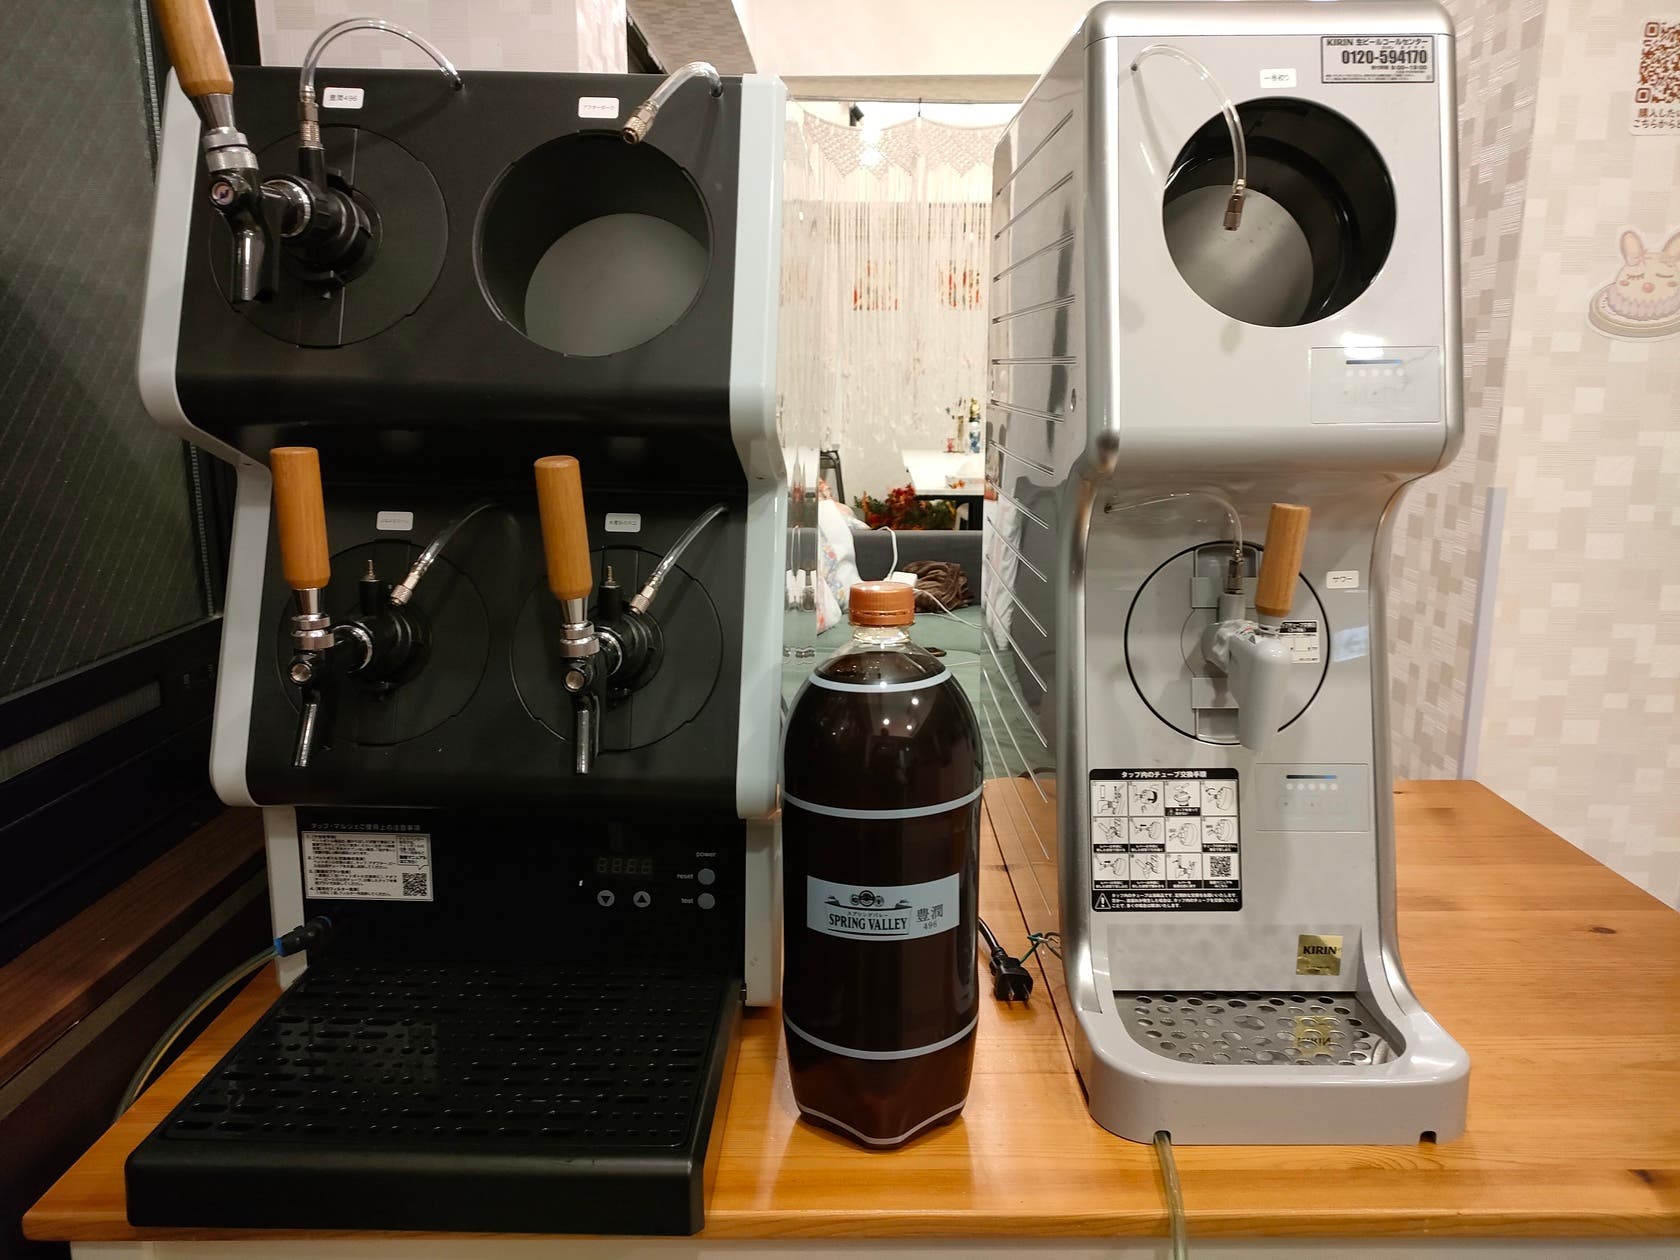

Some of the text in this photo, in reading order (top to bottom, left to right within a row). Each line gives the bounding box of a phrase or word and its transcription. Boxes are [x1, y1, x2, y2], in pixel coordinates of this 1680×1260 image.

[1356, 38, 1429, 46] 生ビールコールセンター
[1341, 50, 1428, 64] 0120-594170
[915, 903, 944, 922] 豊潤
[828, 913, 908, 931] SPRING VALLEY
[923, 921, 938, 930] 496
[1303, 945, 1337, 955] KIRIN
